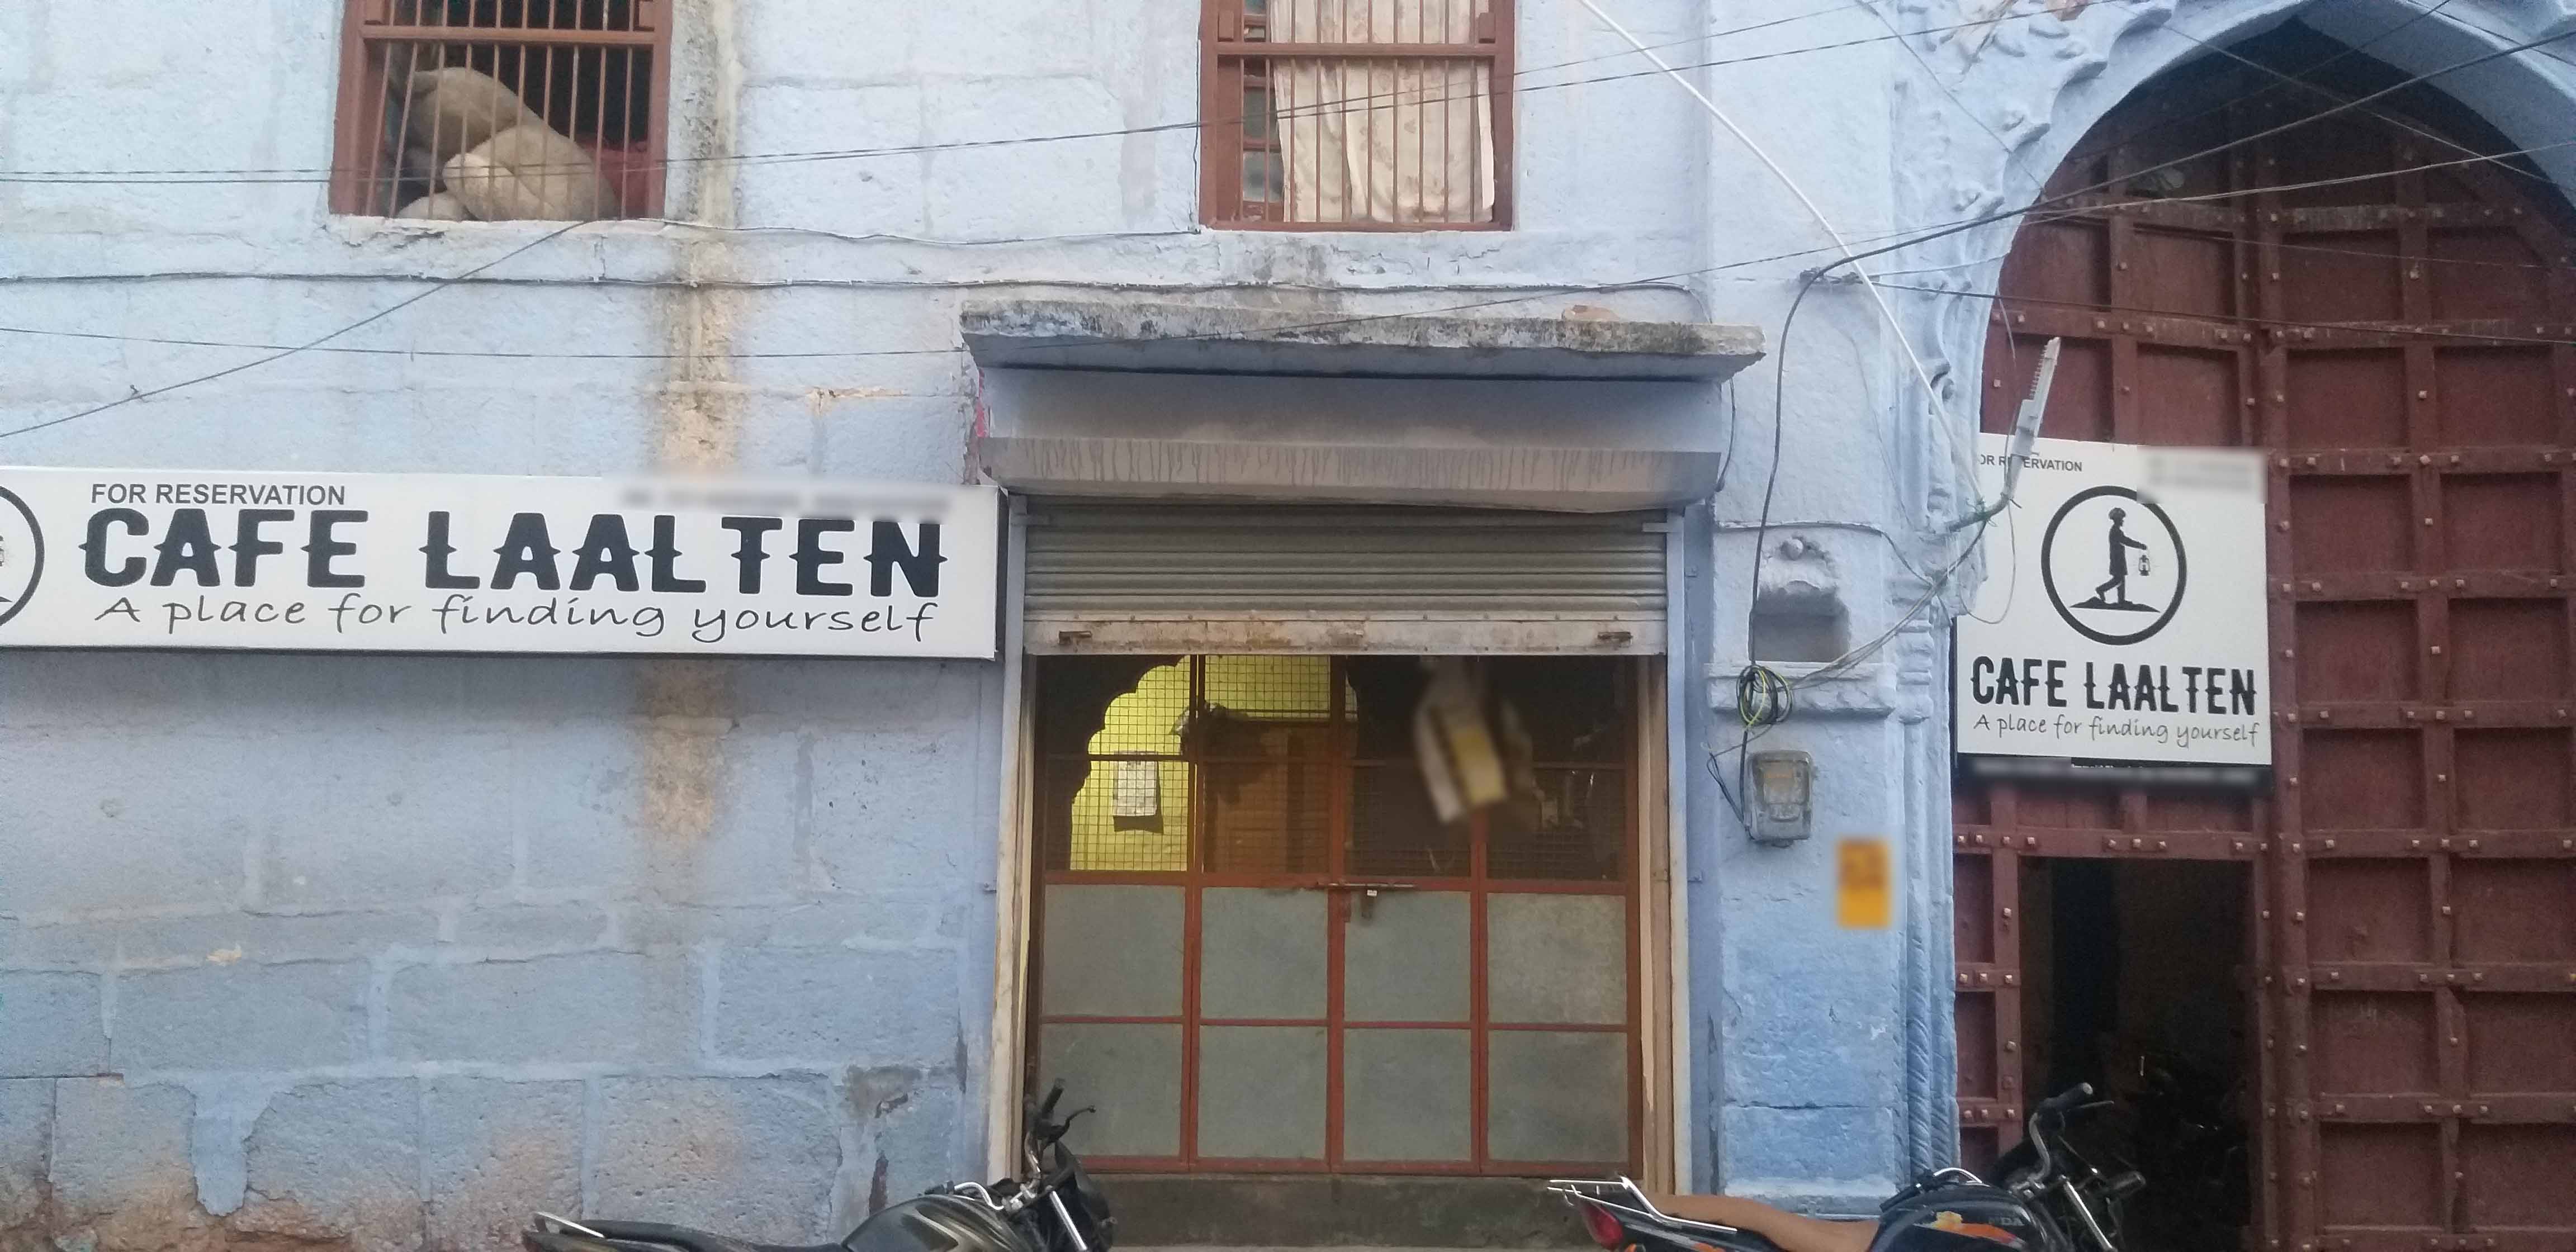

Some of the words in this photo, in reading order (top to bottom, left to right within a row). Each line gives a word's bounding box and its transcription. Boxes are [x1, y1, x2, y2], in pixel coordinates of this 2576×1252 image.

[1980, 454, 1995, 466] OR
[1999, 455, 2082, 472] RERVATION
[92, 483, 146, 504] FOR
[156, 484, 345, 505] RESERVATION
[78, 508, 368, 588] CAFE
[419, 511, 948, 597] LAALTEN
[94, 597, 140, 623] A
[162, 594, 305, 634] place
[328, 592, 411, 633] for
[432, 594, 664, 637] finding
[692, 602, 938, 643] yourself
[1970, 656, 2067, 708] CAFE
[2083, 662, 2257, 716] LAALTEN
[1973, 714, 1990, 731] A
[1996, 713, 2047, 738] place
[2053, 714, 2082, 739] for
[2089, 715, 2168, 744] finding
[2177, 723, 2260, 749] yourself
